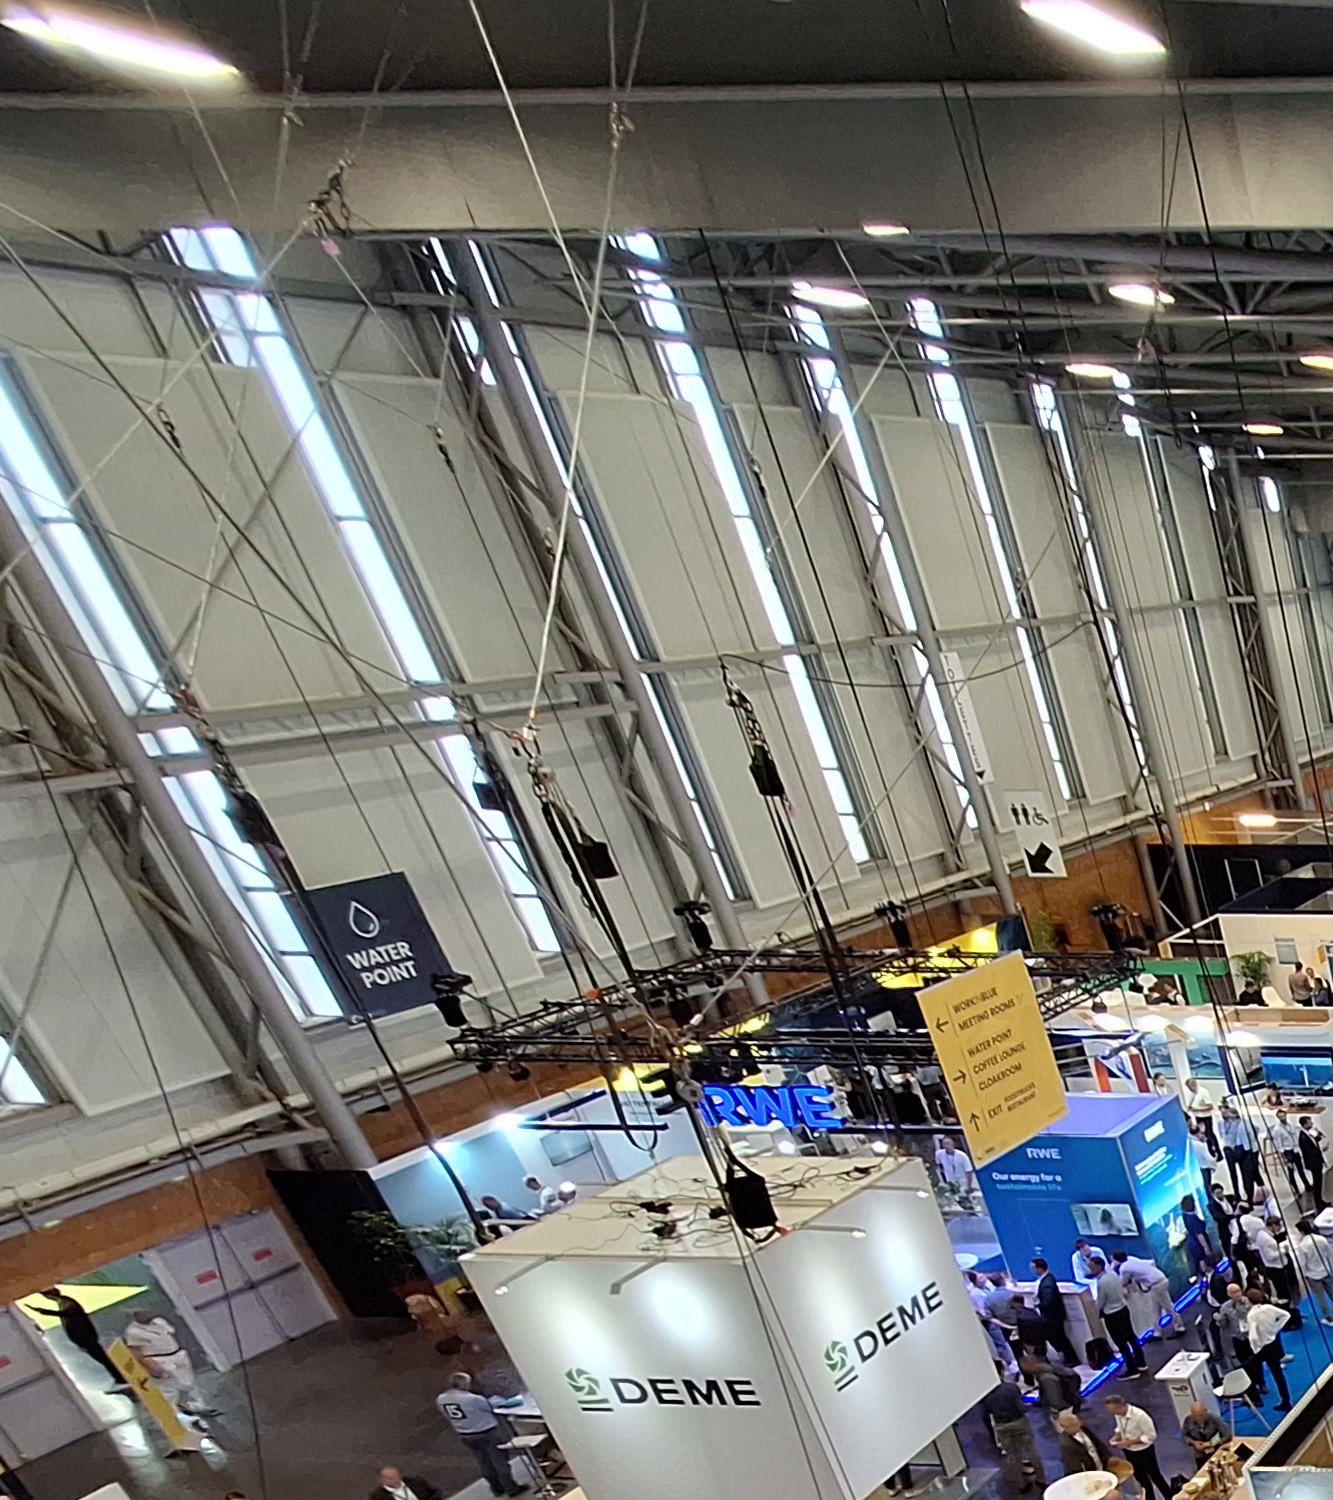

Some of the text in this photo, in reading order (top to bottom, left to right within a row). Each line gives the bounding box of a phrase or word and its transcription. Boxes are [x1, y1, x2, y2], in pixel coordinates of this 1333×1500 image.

[346, 941, 414, 970] WATER
[360, 960, 418, 989] POINT
[957, 998, 1016, 1032] MEETING ROOMS
[967, 1029, 1013, 1058] WATER POINT
[973, 1055, 999, 1075] COFFEE
[978, 1062, 1023, 1091] CLOAKROOM
[701, 1084, 844, 1129] RWE
[987, 1104, 1004, 1120] EXIT
[1026, 1146, 1062, 1160] RWE
[992, 1172, 1009, 1182] Our
[1010, 1173, 1040, 1183] energy
[853, 1280, 944, 1364] DEME
[609, 1376, 761, 1407] DEME
